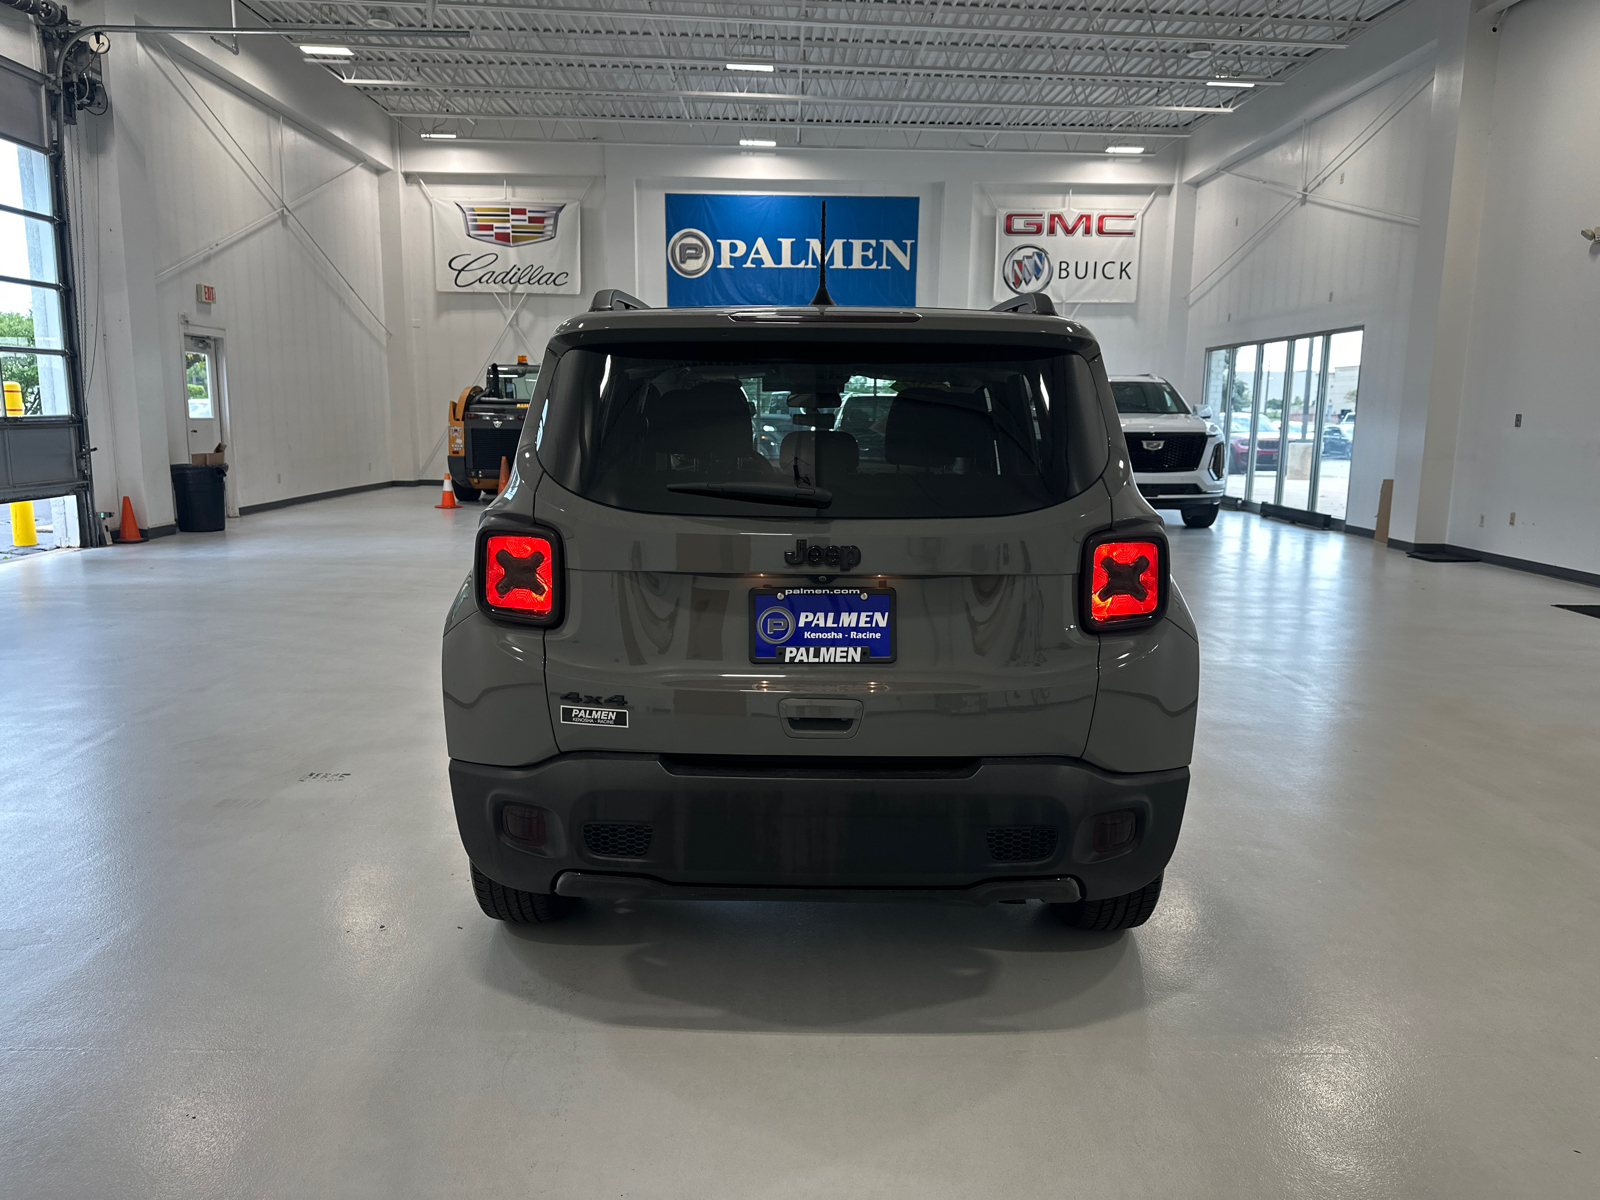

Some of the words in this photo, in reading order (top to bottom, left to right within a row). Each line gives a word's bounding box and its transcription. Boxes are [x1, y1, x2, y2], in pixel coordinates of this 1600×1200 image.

[1003, 211, 1137, 237] GMC
[716, 236, 916, 271] PALMEN
[448, 252, 569, 288] Cadillac
[1058, 261, 1132, 280] BUICK
[784, 539, 862, 572] Jeep
[798, 612, 889, 627] PALMEN
[804, 631, 843, 639] Kenosha
[850, 631, 881, 639] Racine
[784, 647, 862, 663] PALMEN
[560, 692, 628, 706] 4x4
[572, 709, 617, 720] PALMEN
